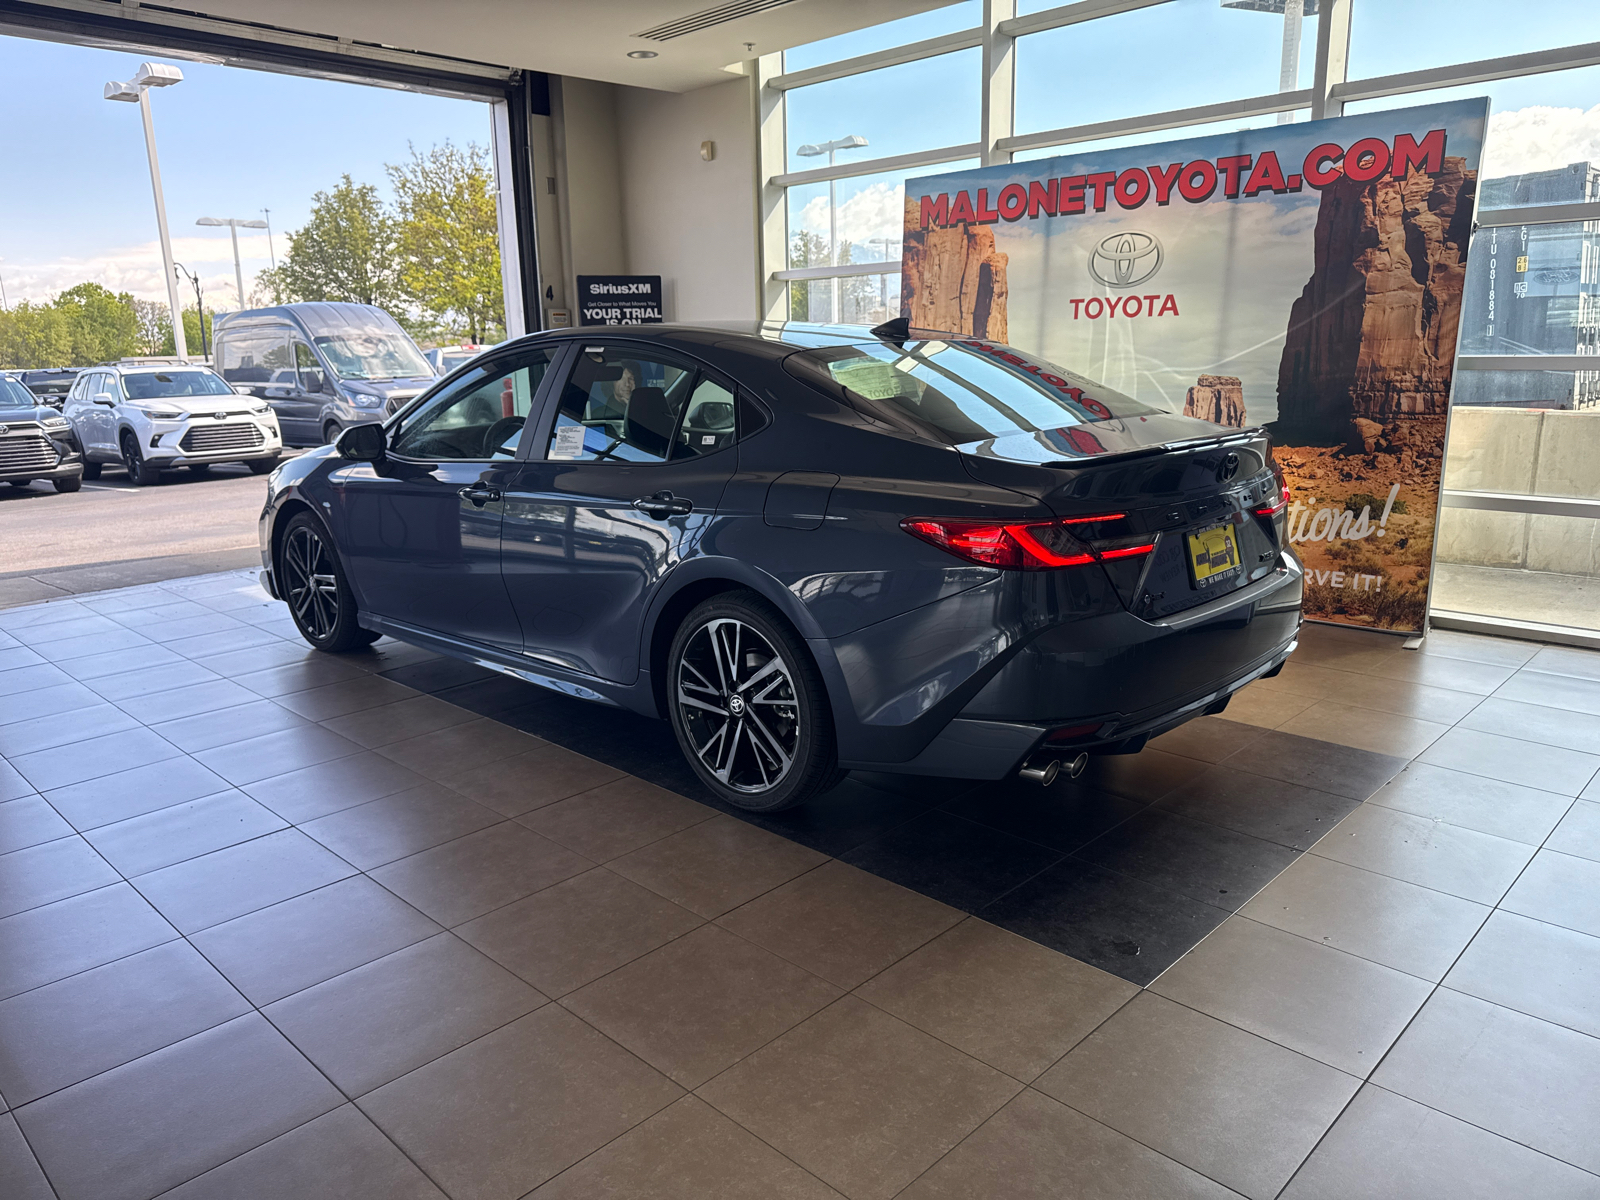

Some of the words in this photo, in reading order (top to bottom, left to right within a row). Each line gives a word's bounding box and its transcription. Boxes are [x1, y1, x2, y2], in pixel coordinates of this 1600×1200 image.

[919, 128, 1448, 230] MALONETOYOTA.COM
[546, 285, 554, 301] 4
[590, 283, 651, 295] SiriusXM
[1488, 258, 1496, 321] 081884
[583, 308, 621, 320] YOUR
[623, 307, 662, 319] TRIAL
[1069, 294, 1180, 321] TOYOTA
[1288, 483, 1400, 544] tions!
[1304, 567, 1346, 588] RVE
[1353, 573, 1383, 593] IT!
